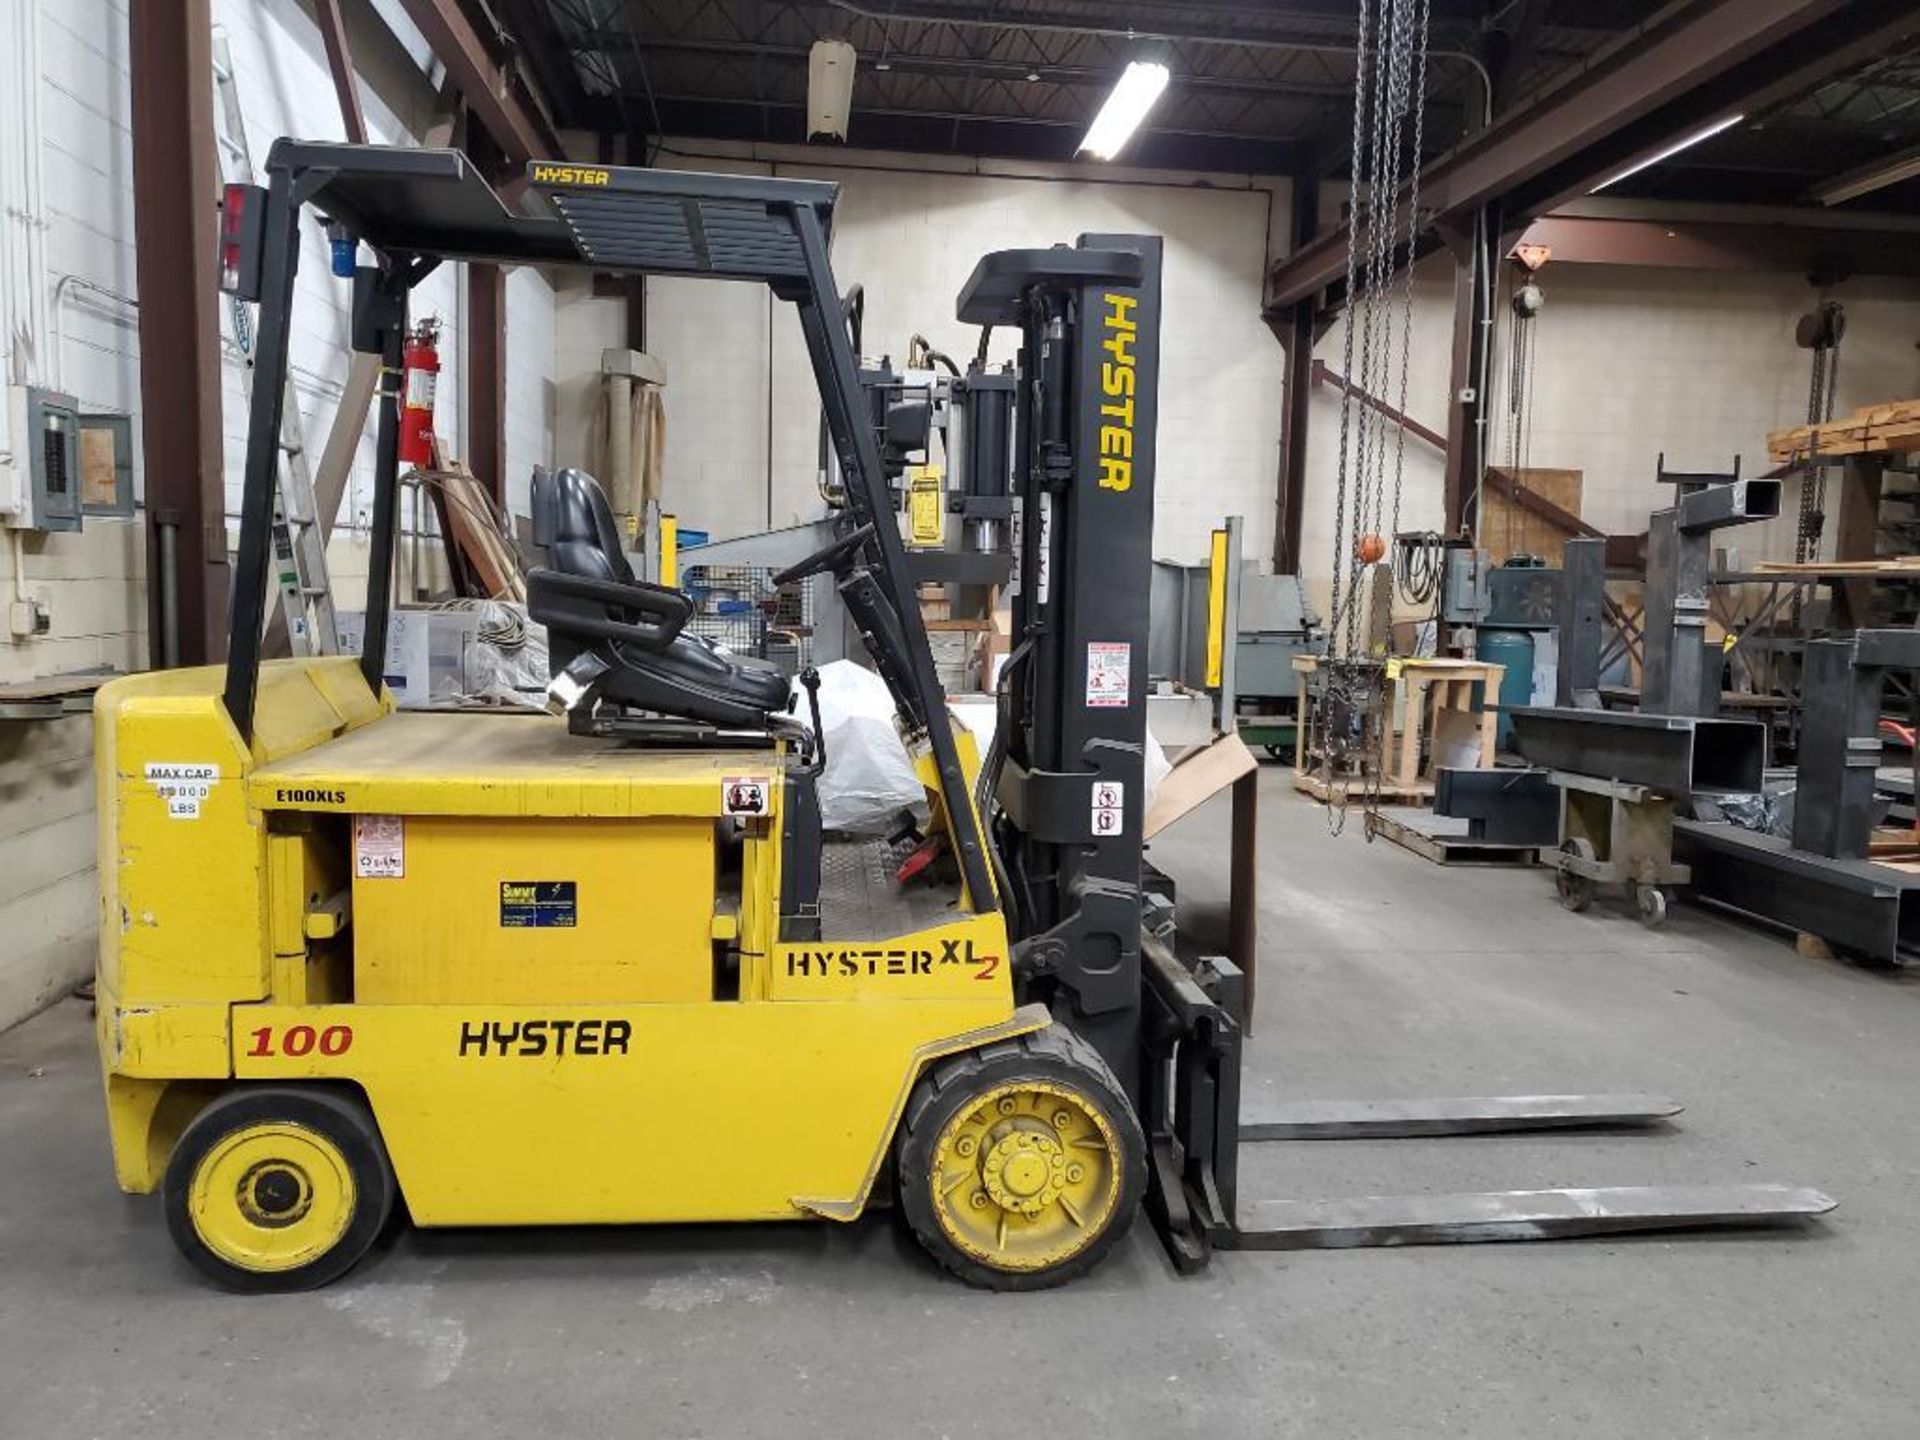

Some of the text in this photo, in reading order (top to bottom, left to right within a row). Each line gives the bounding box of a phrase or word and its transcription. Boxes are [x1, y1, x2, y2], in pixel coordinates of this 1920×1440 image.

[534, 166, 609, 186] HYSTER
[1099, 293, 1137, 492] HYSTER
[150, 768, 181, 780] MAX
[170, 803, 196, 813] LBS
[276, 789, 346, 804] E100XLS
[787, 950, 933, 976] HYSTER
[247, 1025, 353, 1057] 100
[459, 1020, 632, 1057] HYSTER
